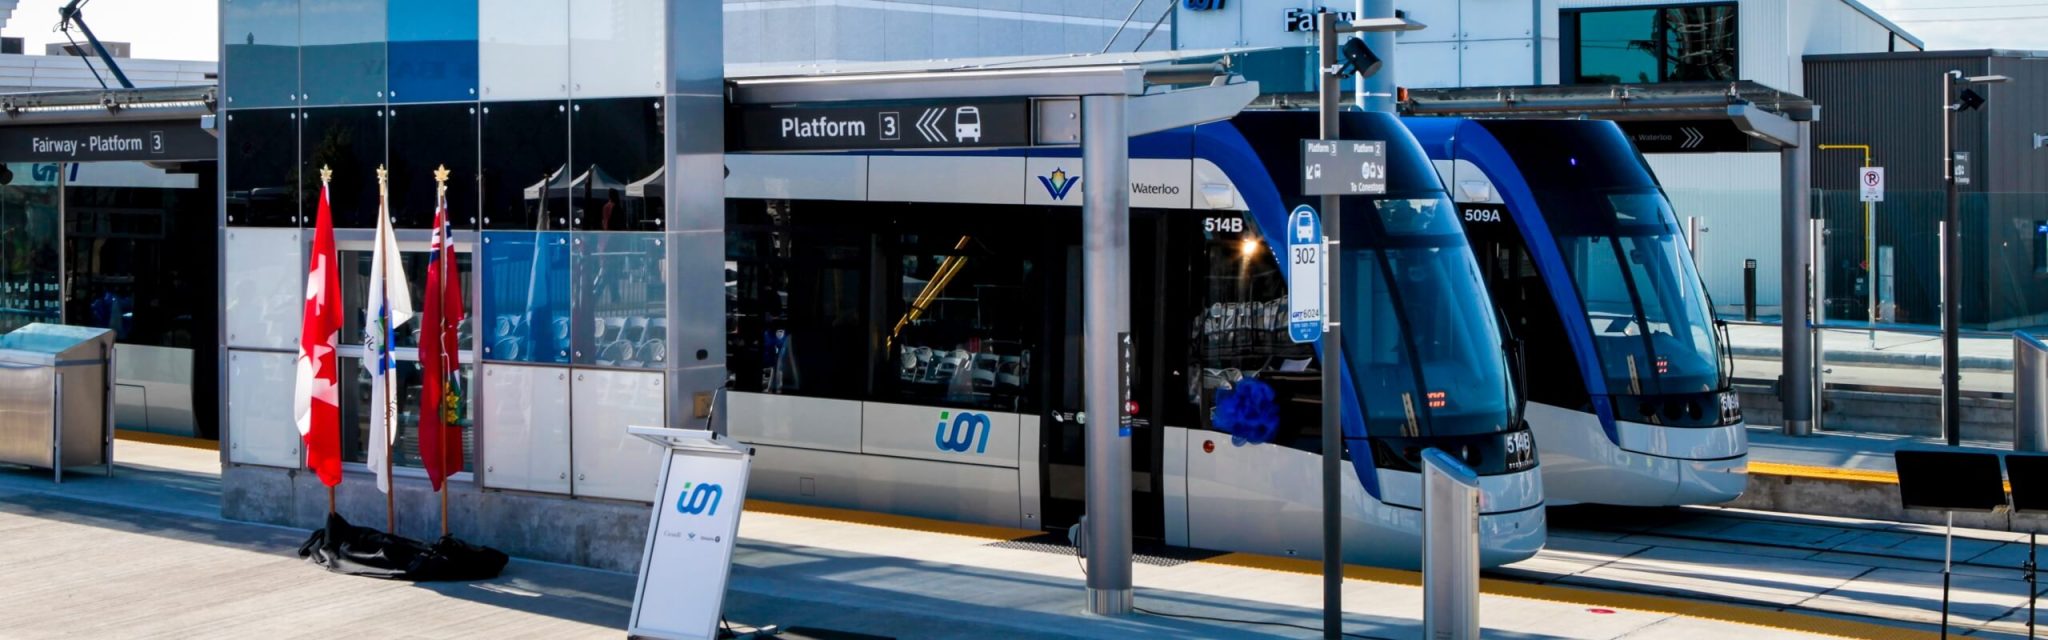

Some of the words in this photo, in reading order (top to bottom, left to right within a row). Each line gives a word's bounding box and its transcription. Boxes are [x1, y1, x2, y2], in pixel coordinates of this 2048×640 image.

[781, 116, 866, 138] Platform
[883, 116, 897, 137] 3
[33, 137, 78, 157] Fairway
[89, 134, 143, 152] Platform
[153, 134, 162, 151] 3
[1308, 143, 1329, 153] Platform
[1353, 143, 1374, 153] Platform
[1131, 182, 1180, 195] Waterloo
[1350, 181, 1358, 193] To
[1464, 209, 1501, 222] 509A
[1204, 217, 1244, 233] 514B
[1295, 247, 1316, 265] 302
